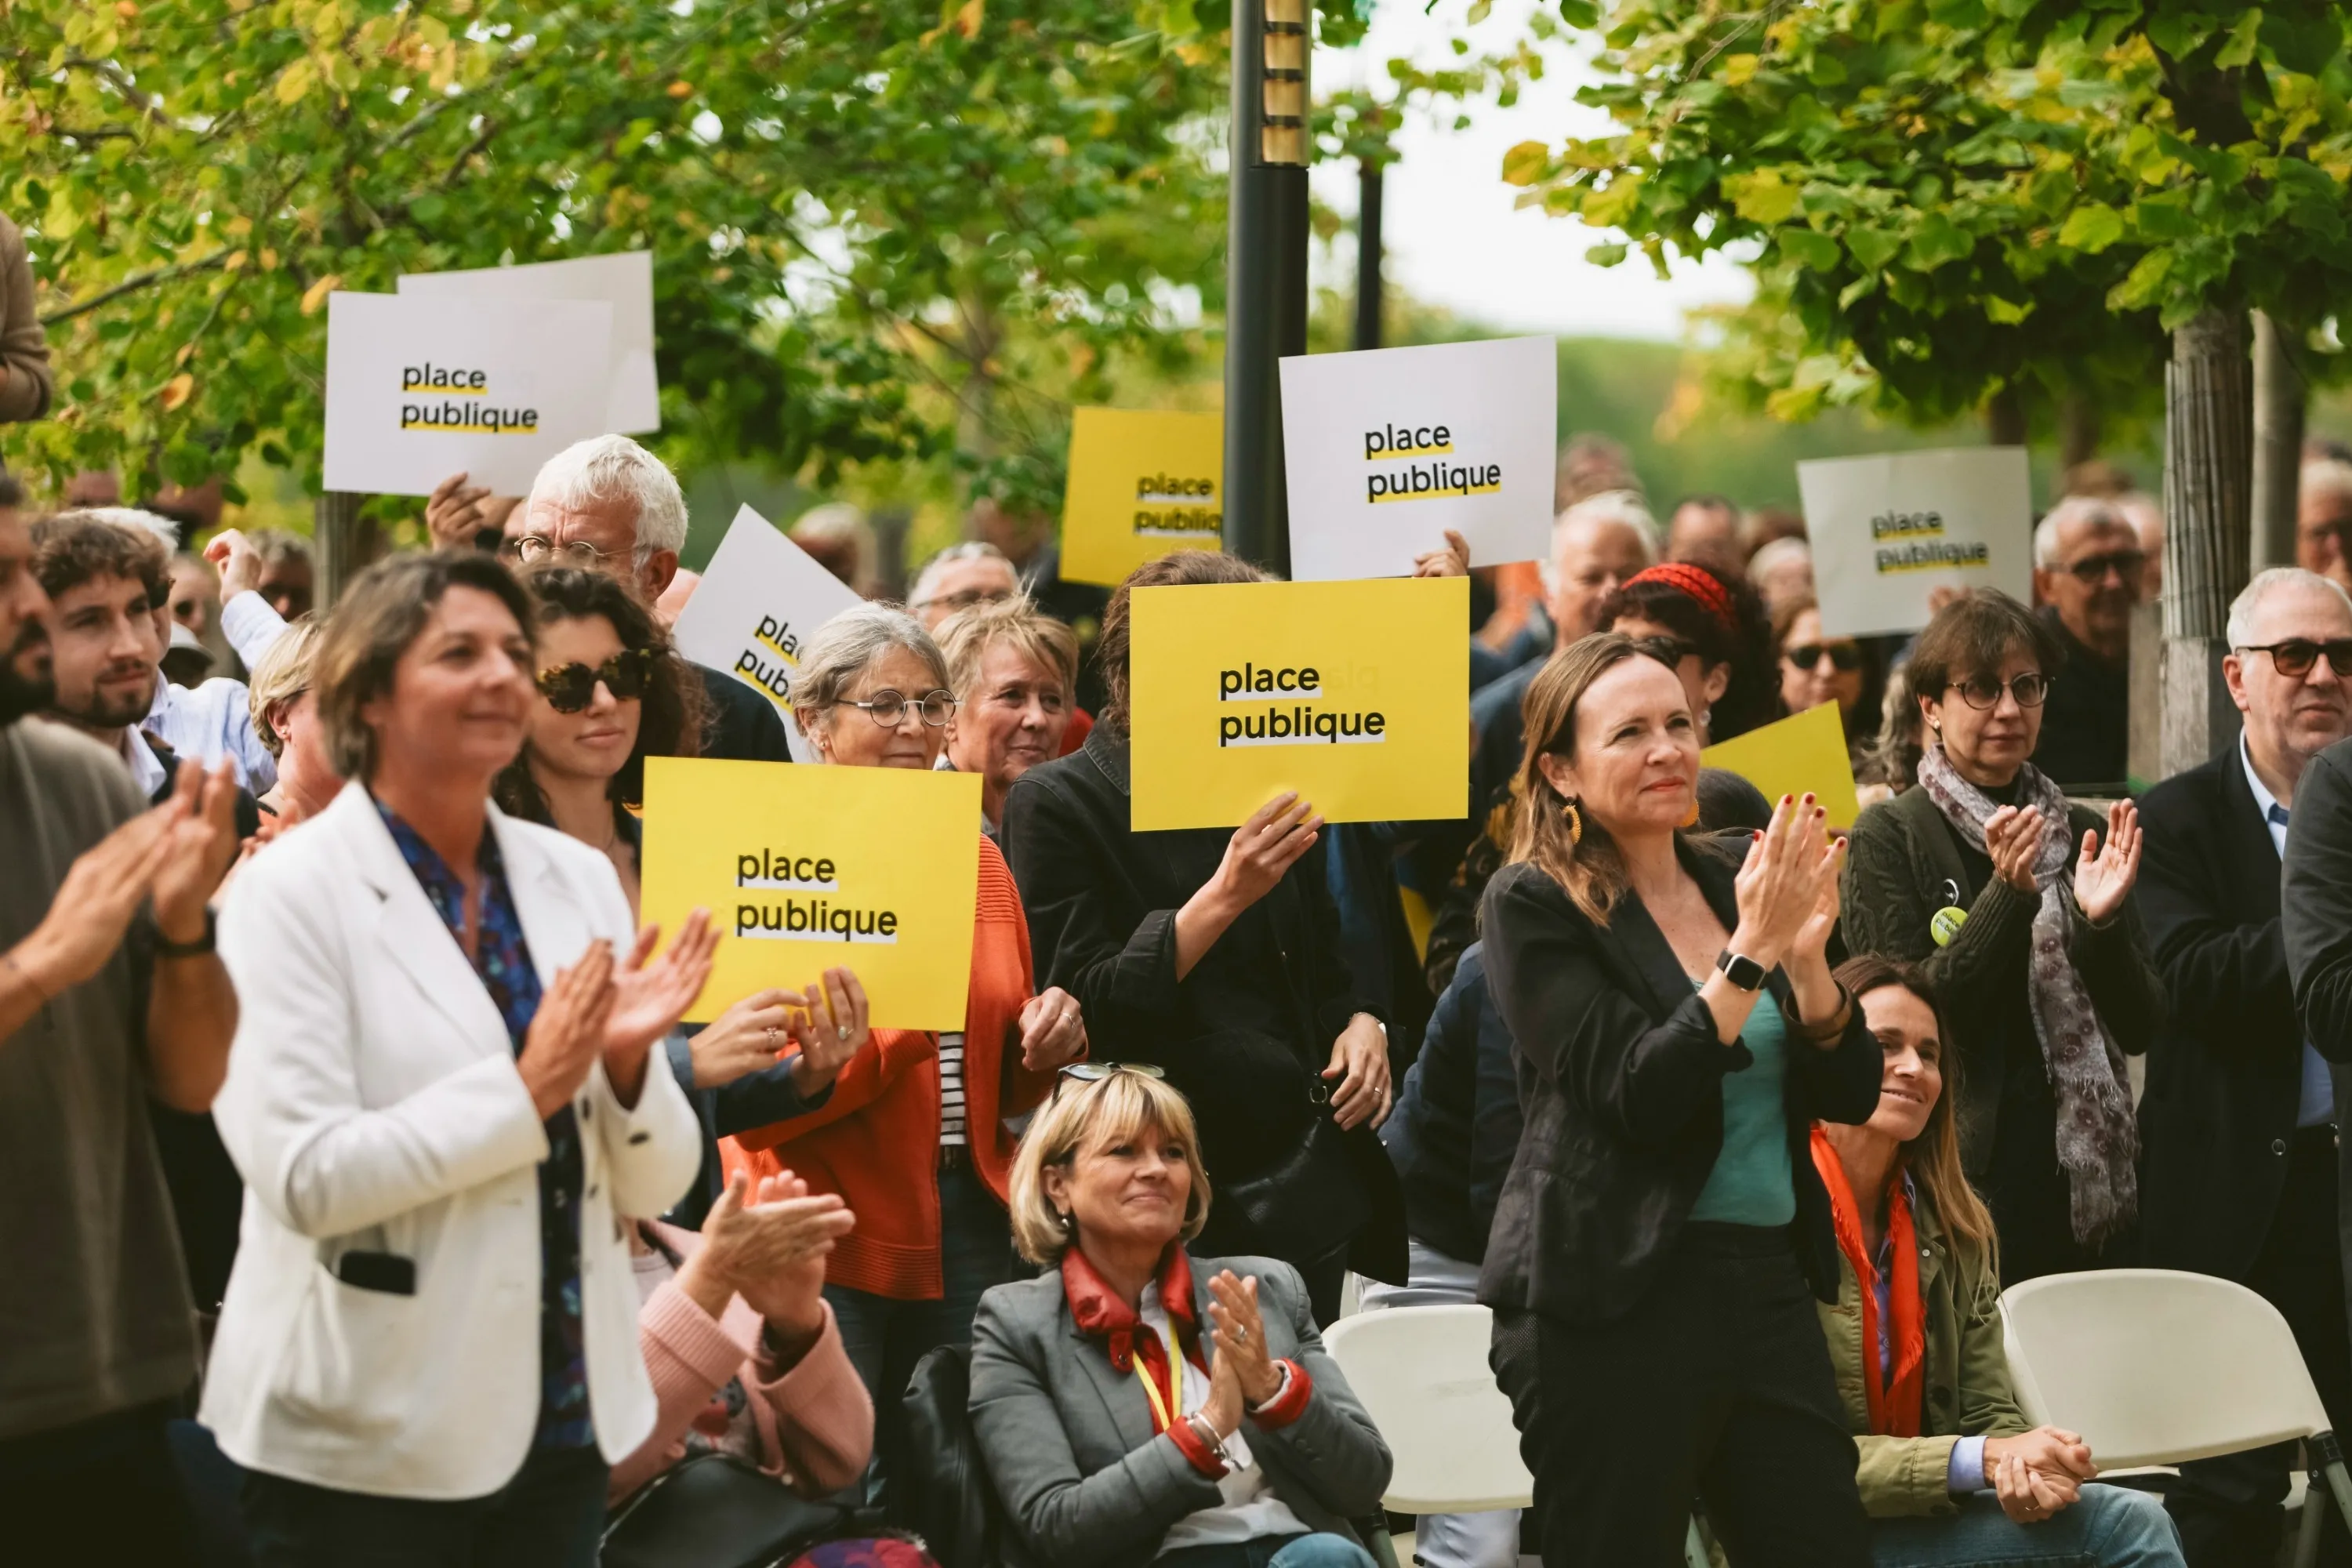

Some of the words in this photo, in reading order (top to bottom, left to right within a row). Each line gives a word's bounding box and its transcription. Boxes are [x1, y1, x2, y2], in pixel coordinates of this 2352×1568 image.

[403, 362, 486, 391] place
[401, 400, 539, 433] publique
[1365, 423, 1450, 460] place
[1137, 471, 1214, 499] place
[1367, 463, 1501, 503] publique
[1871, 509, 1944, 539] place
[1876, 539, 1989, 572] publique
[734, 648, 791, 704] pub
[1221, 662, 1320, 701] place
[1221, 706, 1385, 747] publique
[738, 848, 836, 887] place
[737, 898, 898, 942] publique
